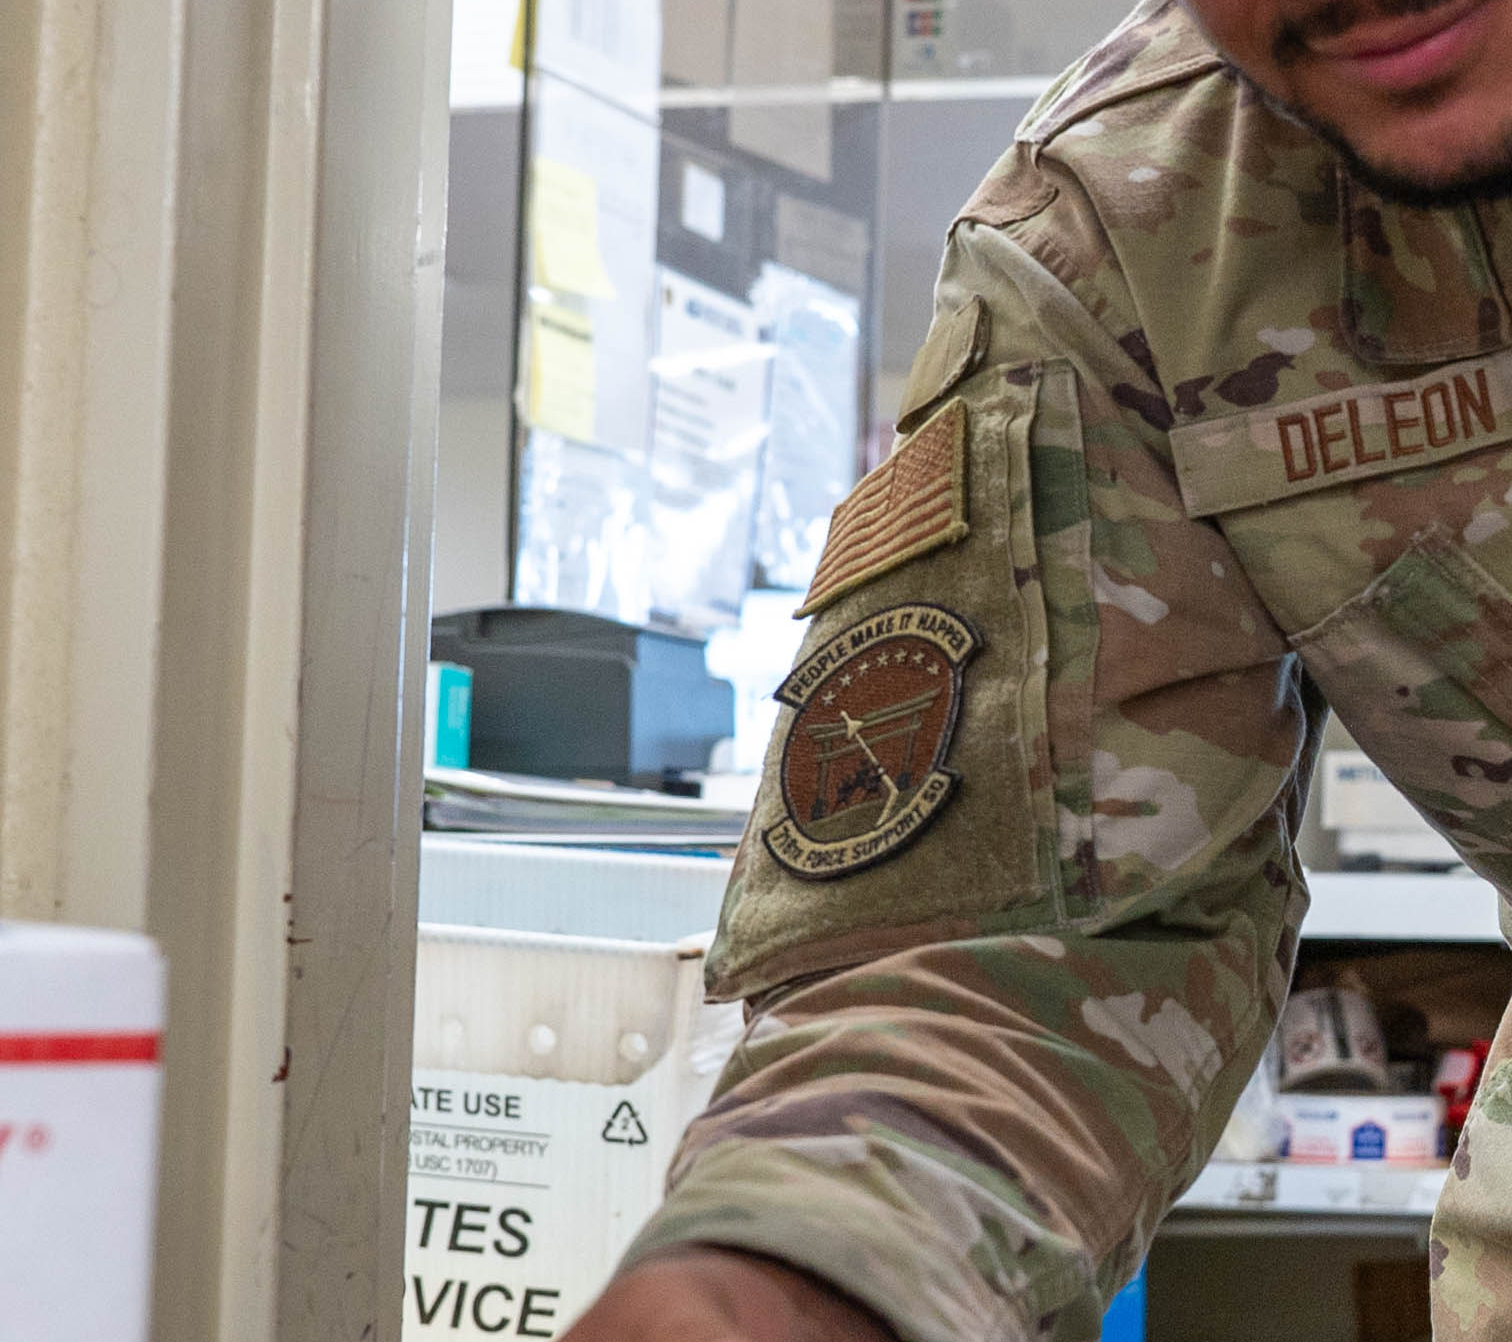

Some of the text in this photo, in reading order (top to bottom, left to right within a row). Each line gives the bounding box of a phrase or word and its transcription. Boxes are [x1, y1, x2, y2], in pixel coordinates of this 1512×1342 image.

[1276, 367, 1497, 484] DELEON
[790, 612, 966, 699] PEOPLE MAKE IT HAPPEN
[852, 803, 925, 860] SUPPORT
[463, 1091, 522, 1120] USE
[415, 1154, 498, 1183] USC 1707)
[454, 1133, 549, 1159] PROPERTY
[414, 1198, 533, 1258] TES
[413, 1275, 560, 1338] VICE
